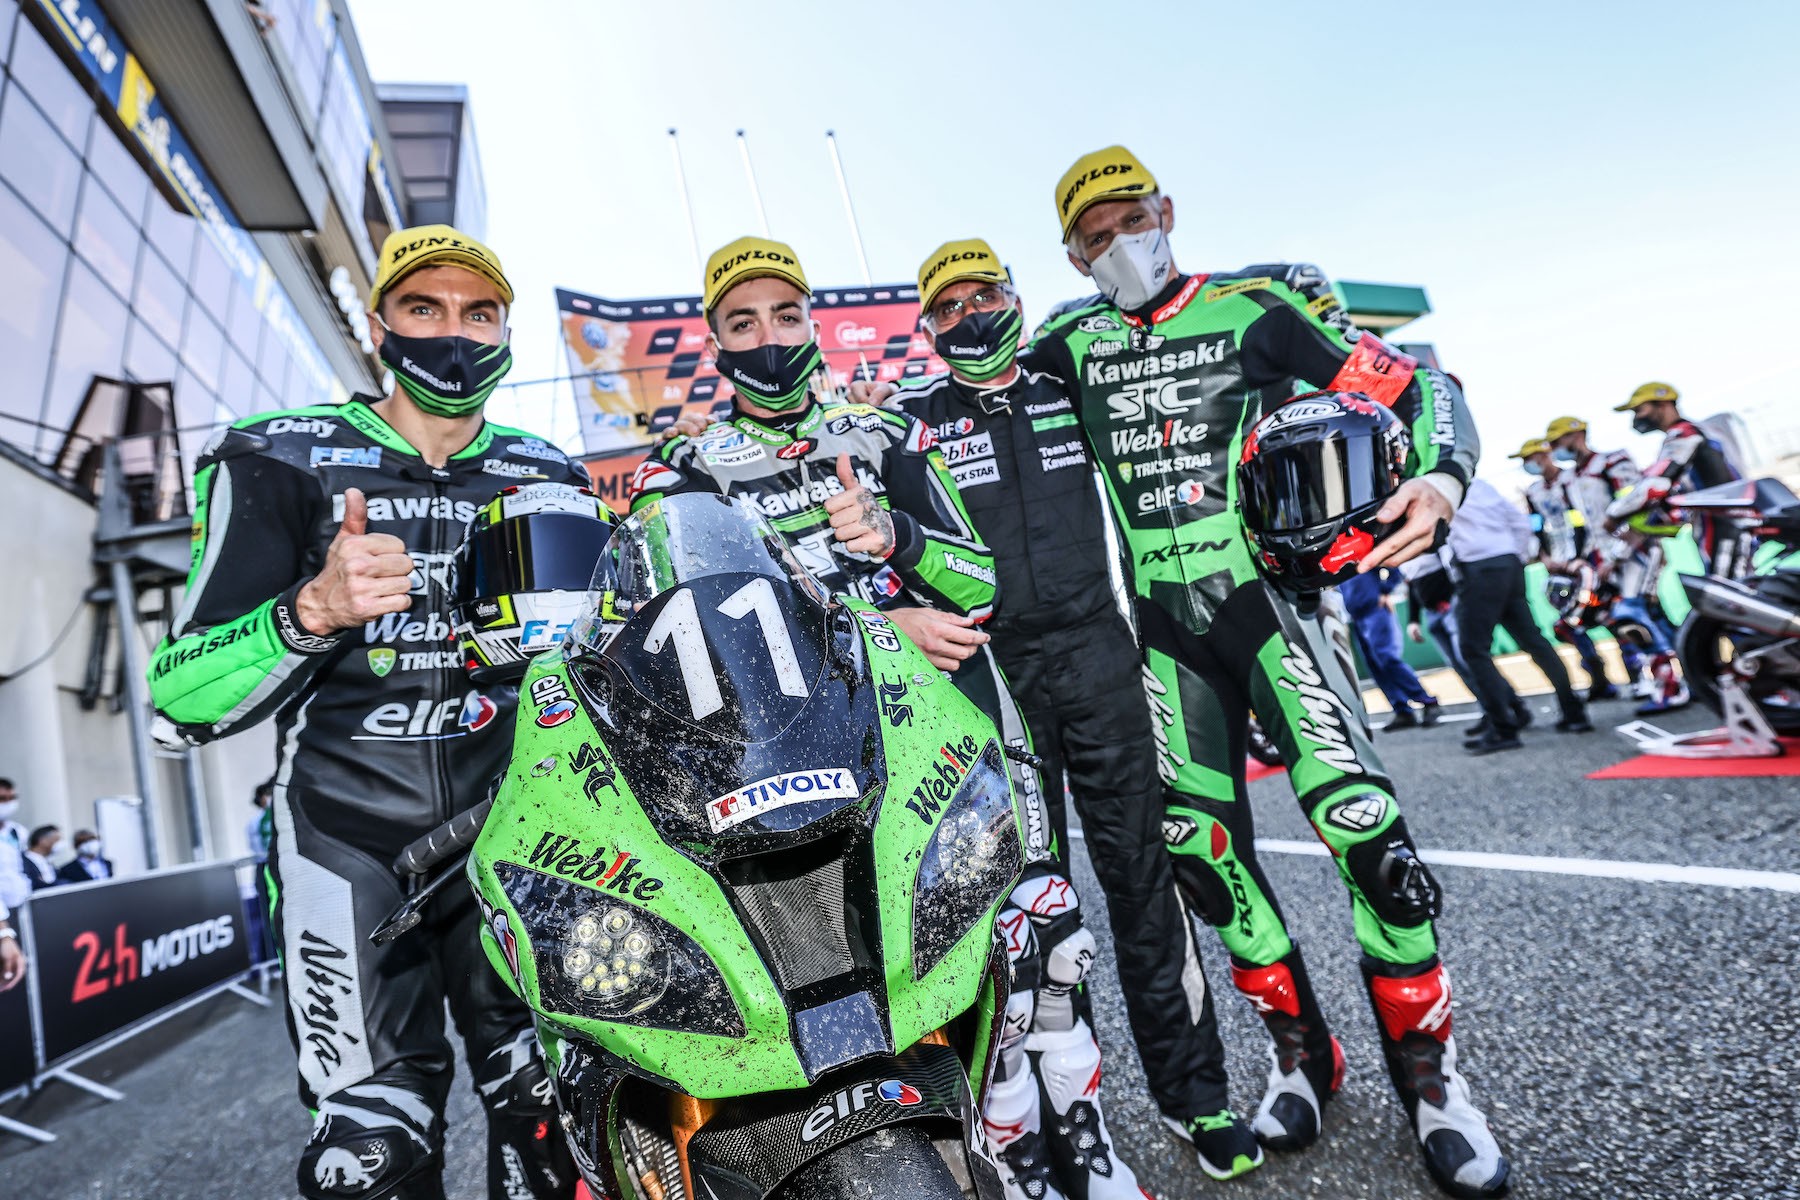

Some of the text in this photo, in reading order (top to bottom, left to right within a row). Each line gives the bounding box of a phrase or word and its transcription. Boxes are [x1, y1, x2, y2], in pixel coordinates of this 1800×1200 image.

[1062, 164, 1133, 215] DUNLOP
[712, 250, 794, 284] DUNLOP
[922, 251, 988, 291] DUNLOP
[949, 343, 988, 356] Kawasaki
[1087, 339, 1226, 387] Kawasaki
[401, 357, 462, 392] Kawasaki
[733, 368, 780, 392] Kawasaki
[1024, 398, 1072, 416] Kawasaki
[719, 448, 762, 464] TRICK STAR
[1038, 444, 1065, 458] Team
[1042, 451, 1087, 472] Kawasaki
[1134, 453, 1212, 479] TRICK STAR
[969, 466, 994, 480] STAR
[943, 551, 996, 587] Kawasaki
[153, 617, 259, 682] Kawasaki
[643, 577, 810, 721] 11
[742, 772, 842, 807] TIVOLY
[141, 914, 235, 978] MOTOS
